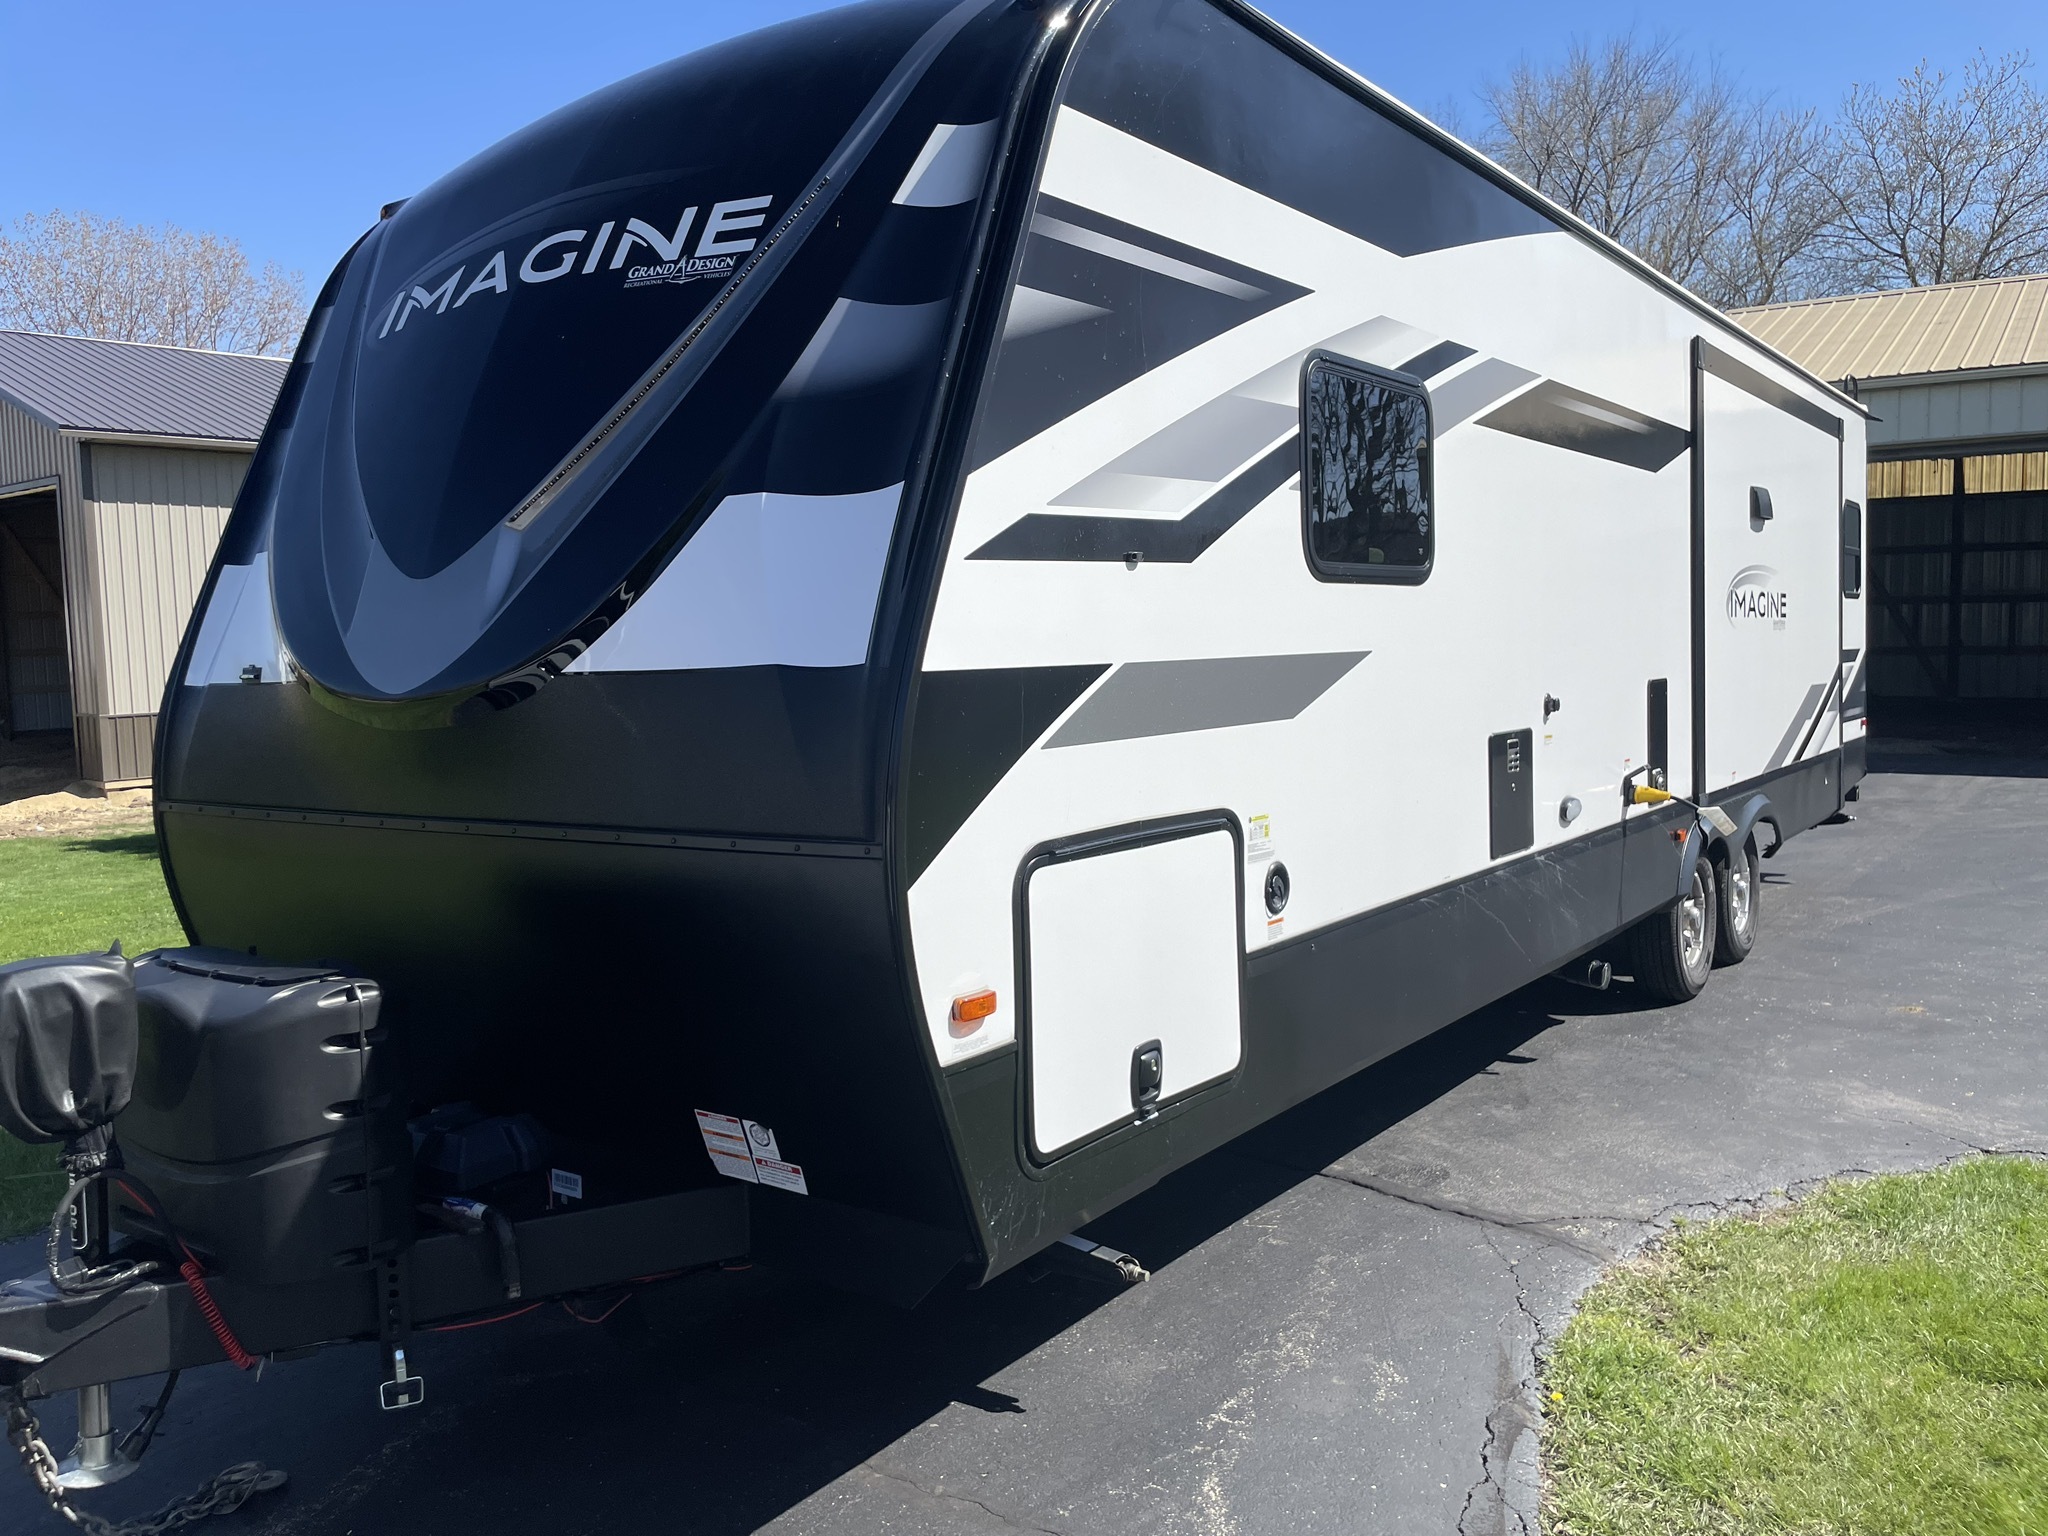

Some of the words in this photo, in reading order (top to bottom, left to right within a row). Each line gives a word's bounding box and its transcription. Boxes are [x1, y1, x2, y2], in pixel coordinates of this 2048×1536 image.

[379, 195, 773, 339] IMAGINE
[623, 279, 663, 289] RECREATIONAL
[704, 271, 731, 280] VEHICLES
[628, 263, 675, 279] GRAND
[686, 256, 736, 272] DESIGN
[1730, 589, 1787, 618] IMAGINE
